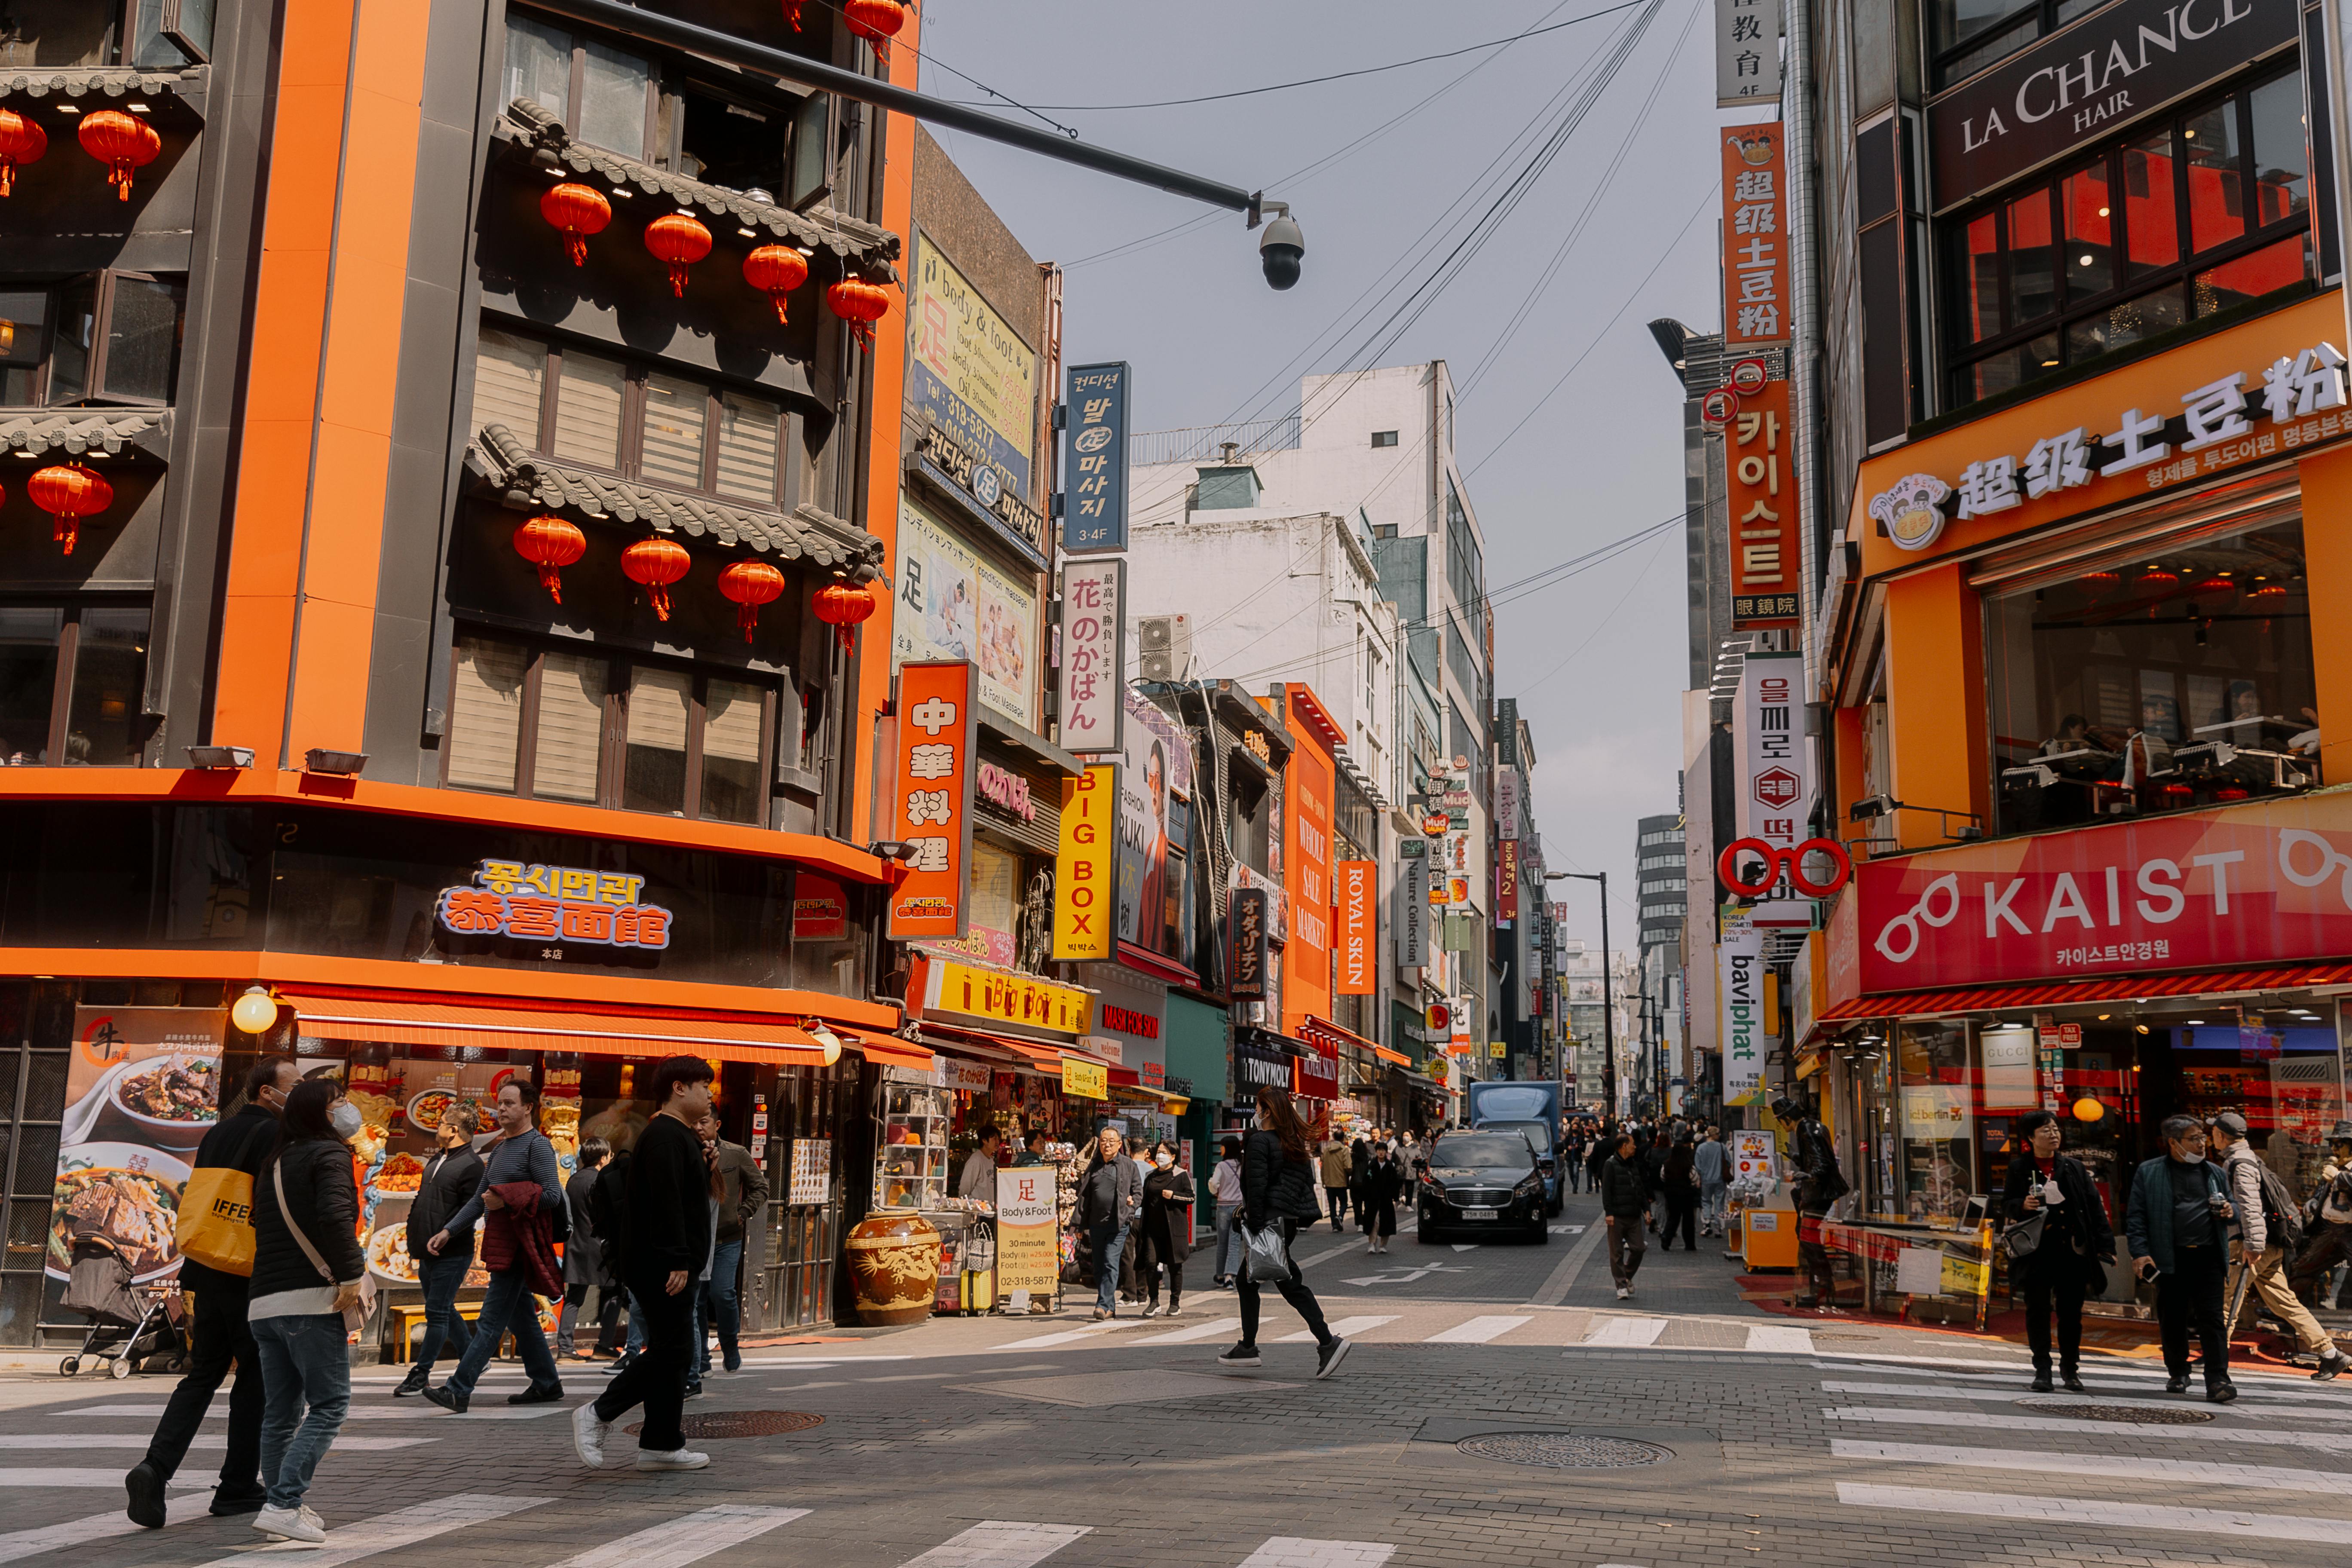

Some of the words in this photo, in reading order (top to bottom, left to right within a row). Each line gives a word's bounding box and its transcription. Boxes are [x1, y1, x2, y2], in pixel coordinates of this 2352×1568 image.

[1740, 85, 1759, 95] 4F
[1961, 107, 2009, 154] LA
[2073, 90, 2134, 134] HAIR
[1733, 170, 1780, 337] 超级土豆粉
[919, 291, 948, 378] 足
[943, 269, 973, 325] body
[977, 307, 987, 337] &
[991, 321, 1013, 363] foot
[957, 325, 971, 352] foot
[953, 345, 971, 377] body
[959, 377, 970, 398] Oil
[1074, 373, 1119, 393] 컨디션
[926, 377, 940, 402] Tel
[948, 394, 994, 450] 318-5877
[1958, 341, 2348, 521] 超级土豆粉
[2146, 460, 2198, 488] 형제들
[2203, 432, 2276, 470] 투도어펀
[928, 427, 973, 486] 컨디션
[1002, 493, 1041, 546] 마사지
[1737, 410, 1783, 585] 카이스트
[901, 556, 923, 613] 足
[978, 565, 1002, 592] condition
[1005, 586, 1027, 609] massage
[1736, 597, 1795, 616] 眼鏡院
[1102, 574, 1113, 681] 最高で勝負します
[1069, 579, 1100, 730] 花のかばん
[989, 688, 1000, 705] Foot
[1001, 695, 1024, 718] Massage
[904, 696, 957, 872] 中華料理
[1443, 793, 1470, 805] Mud
[1761, 780, 1793, 796] 국물
[1073, 771, 1096, 844] BIG
[1425, 818, 1446, 827] Mud
[1299, 815, 1325, 865] WHOLE
[1071, 861, 1093, 934] BOX
[1303, 864, 1321, 905] SALE
[1348, 867, 1363, 935] ROYAL
[1408, 861, 1418, 902] Nature
[1984, 850, 2245, 938] KAIST
[446, 890, 668, 946] 恭喜面館
[1296, 904, 1326, 952] MARKET
[1408, 905, 1419, 963] Collection
[1506, 910, 1516, 918] 3F
[542, 948, 563, 960] 本店
[1348, 936, 1363, 986] SKIN
[2057, 940, 2170, 967] 카이스트안경원
[993, 978, 1018, 1017] Big
[1028, 986, 1052, 1018] Box
[1730, 955, 1756, 1060] baviphat
[92, 1022, 124, 1061] 牛
[1104, 1004, 1127, 1030] MASK
[1127, 1009, 1142, 1034] FOR
[1143, 1012, 1159, 1039] SKIN
[2062, 1034, 2079, 1042] FREE
[111, 1050, 130, 1059] 肉面
[1101, 1043, 1120, 1057] welcome
[1323, 1057, 1336, 1081] SKIN
[1988, 1047, 2029, 1058] GUCCI
[1066, 1066, 1072, 1088] 足
[1099, 1073, 1105, 1095] 身
[1248, 1058, 1290, 1088] TONYMOLY
[1921, 1109, 1949, 1120] berlin
[1017, 1179, 1036, 1202] 足
[1002, 1207, 1051, 1218] Body&Foot
[1001, 1276, 1054, 1286] 02-318-5877
